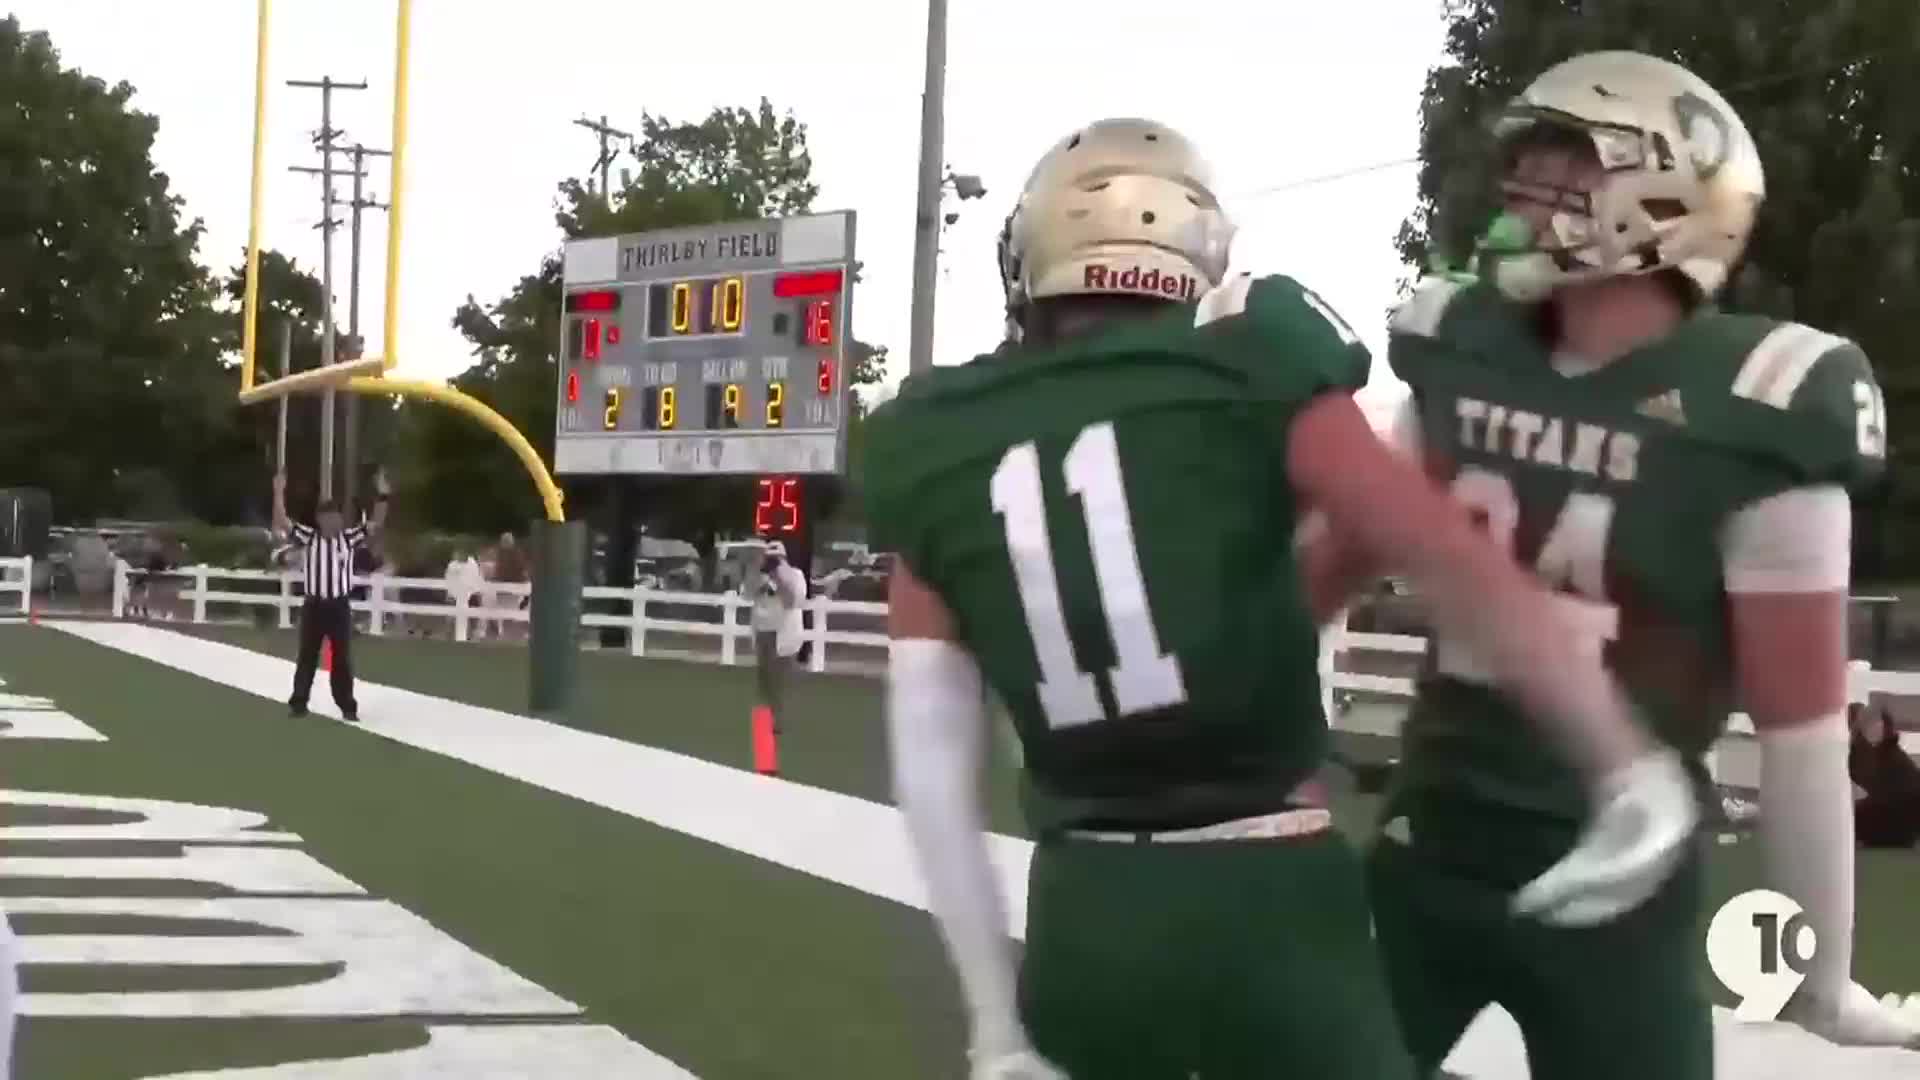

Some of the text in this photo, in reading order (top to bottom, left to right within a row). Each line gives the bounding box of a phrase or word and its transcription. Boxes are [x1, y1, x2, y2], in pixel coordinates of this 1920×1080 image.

[623, 231, 778, 272] THIRLBY FIELD
[1084, 264, 1197, 299] Riddell
[604, 387, 619, 429] 2
[660, 386, 675, 428] 8
[725, 383, 739, 422] 9
[766, 383, 782, 425] 2
[1455, 396, 1641, 482] TITANS
[756, 478, 798, 532] 25
[989, 420, 1189, 731] 11
